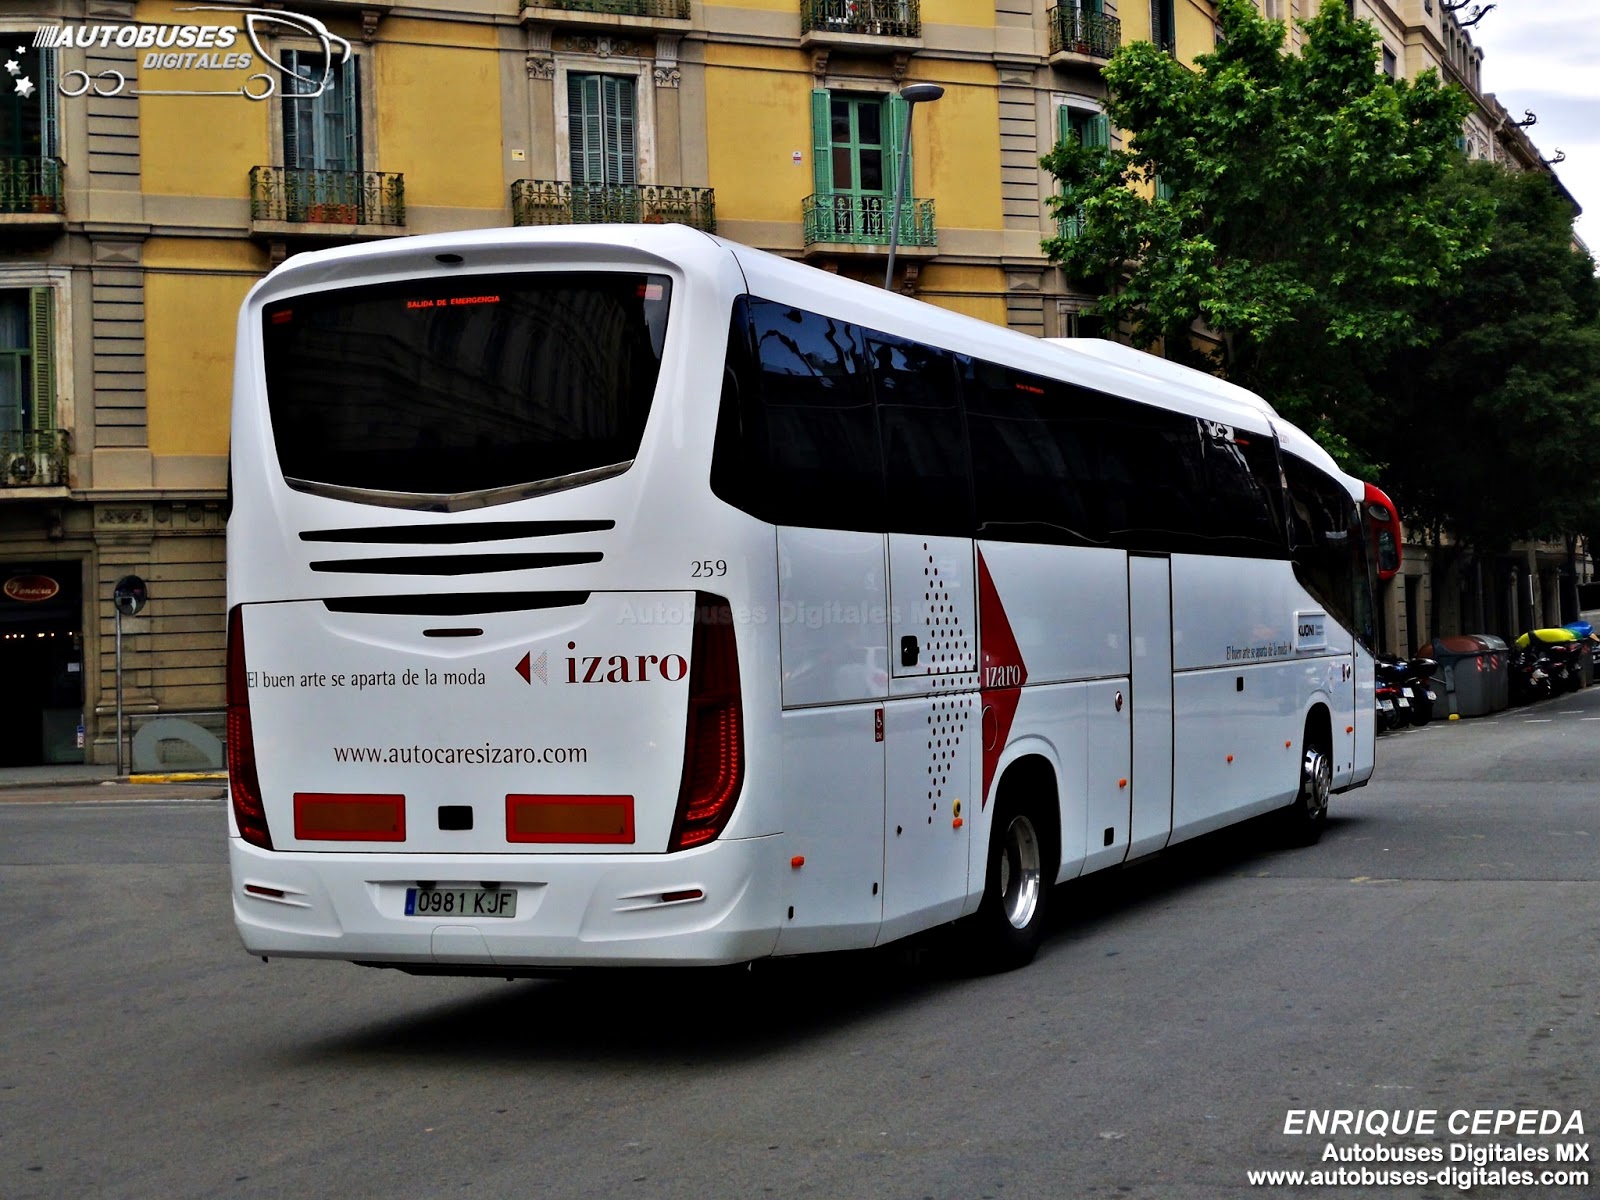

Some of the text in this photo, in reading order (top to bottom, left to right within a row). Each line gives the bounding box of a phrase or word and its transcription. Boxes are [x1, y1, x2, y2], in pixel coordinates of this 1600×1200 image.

[407, 295, 500, 309] SALIDA DE EMERGENCIA
[691, 559, 728, 578] 259
[565, 641, 689, 684] izaro
[985, 655, 1021, 688] izaro
[247, 667, 486, 690] El buen arte se aparta de la moda
[333, 742, 588, 764] www.autocaresizaro.com
[418, 892, 512, 914] 0981 KJF
